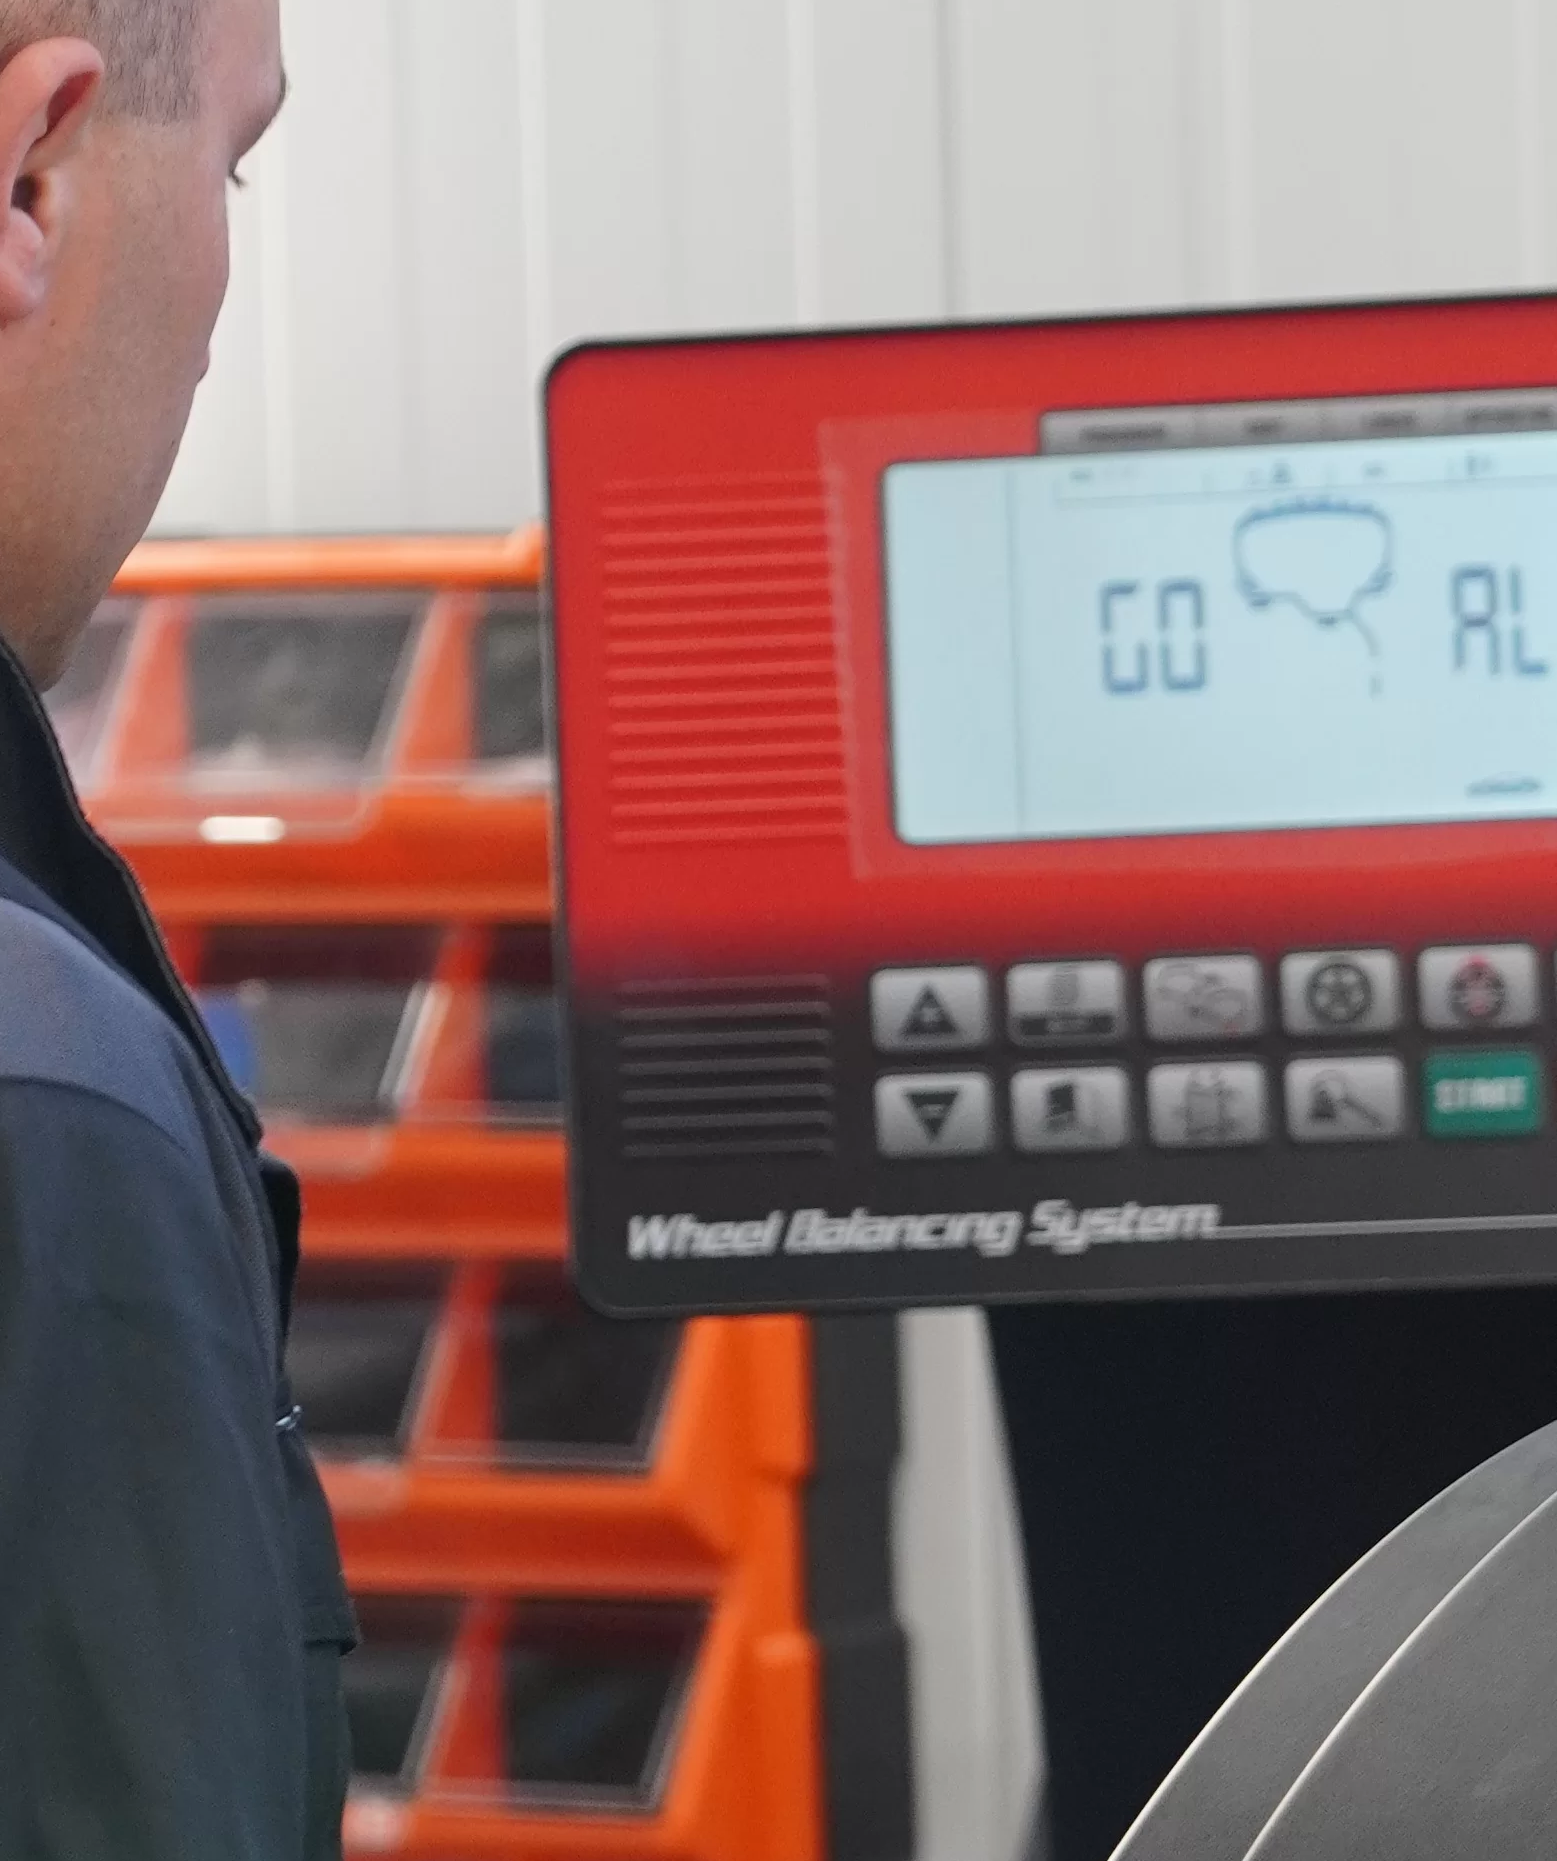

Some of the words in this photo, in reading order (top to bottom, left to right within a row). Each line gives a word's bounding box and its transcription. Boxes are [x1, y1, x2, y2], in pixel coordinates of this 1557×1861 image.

[1434, 1075, 1527, 1114] START
[627, 1209, 785, 1260] Wheel
[783, 1207, 1024, 1258] Balancing
[1030, 1198, 1222, 1255] System
